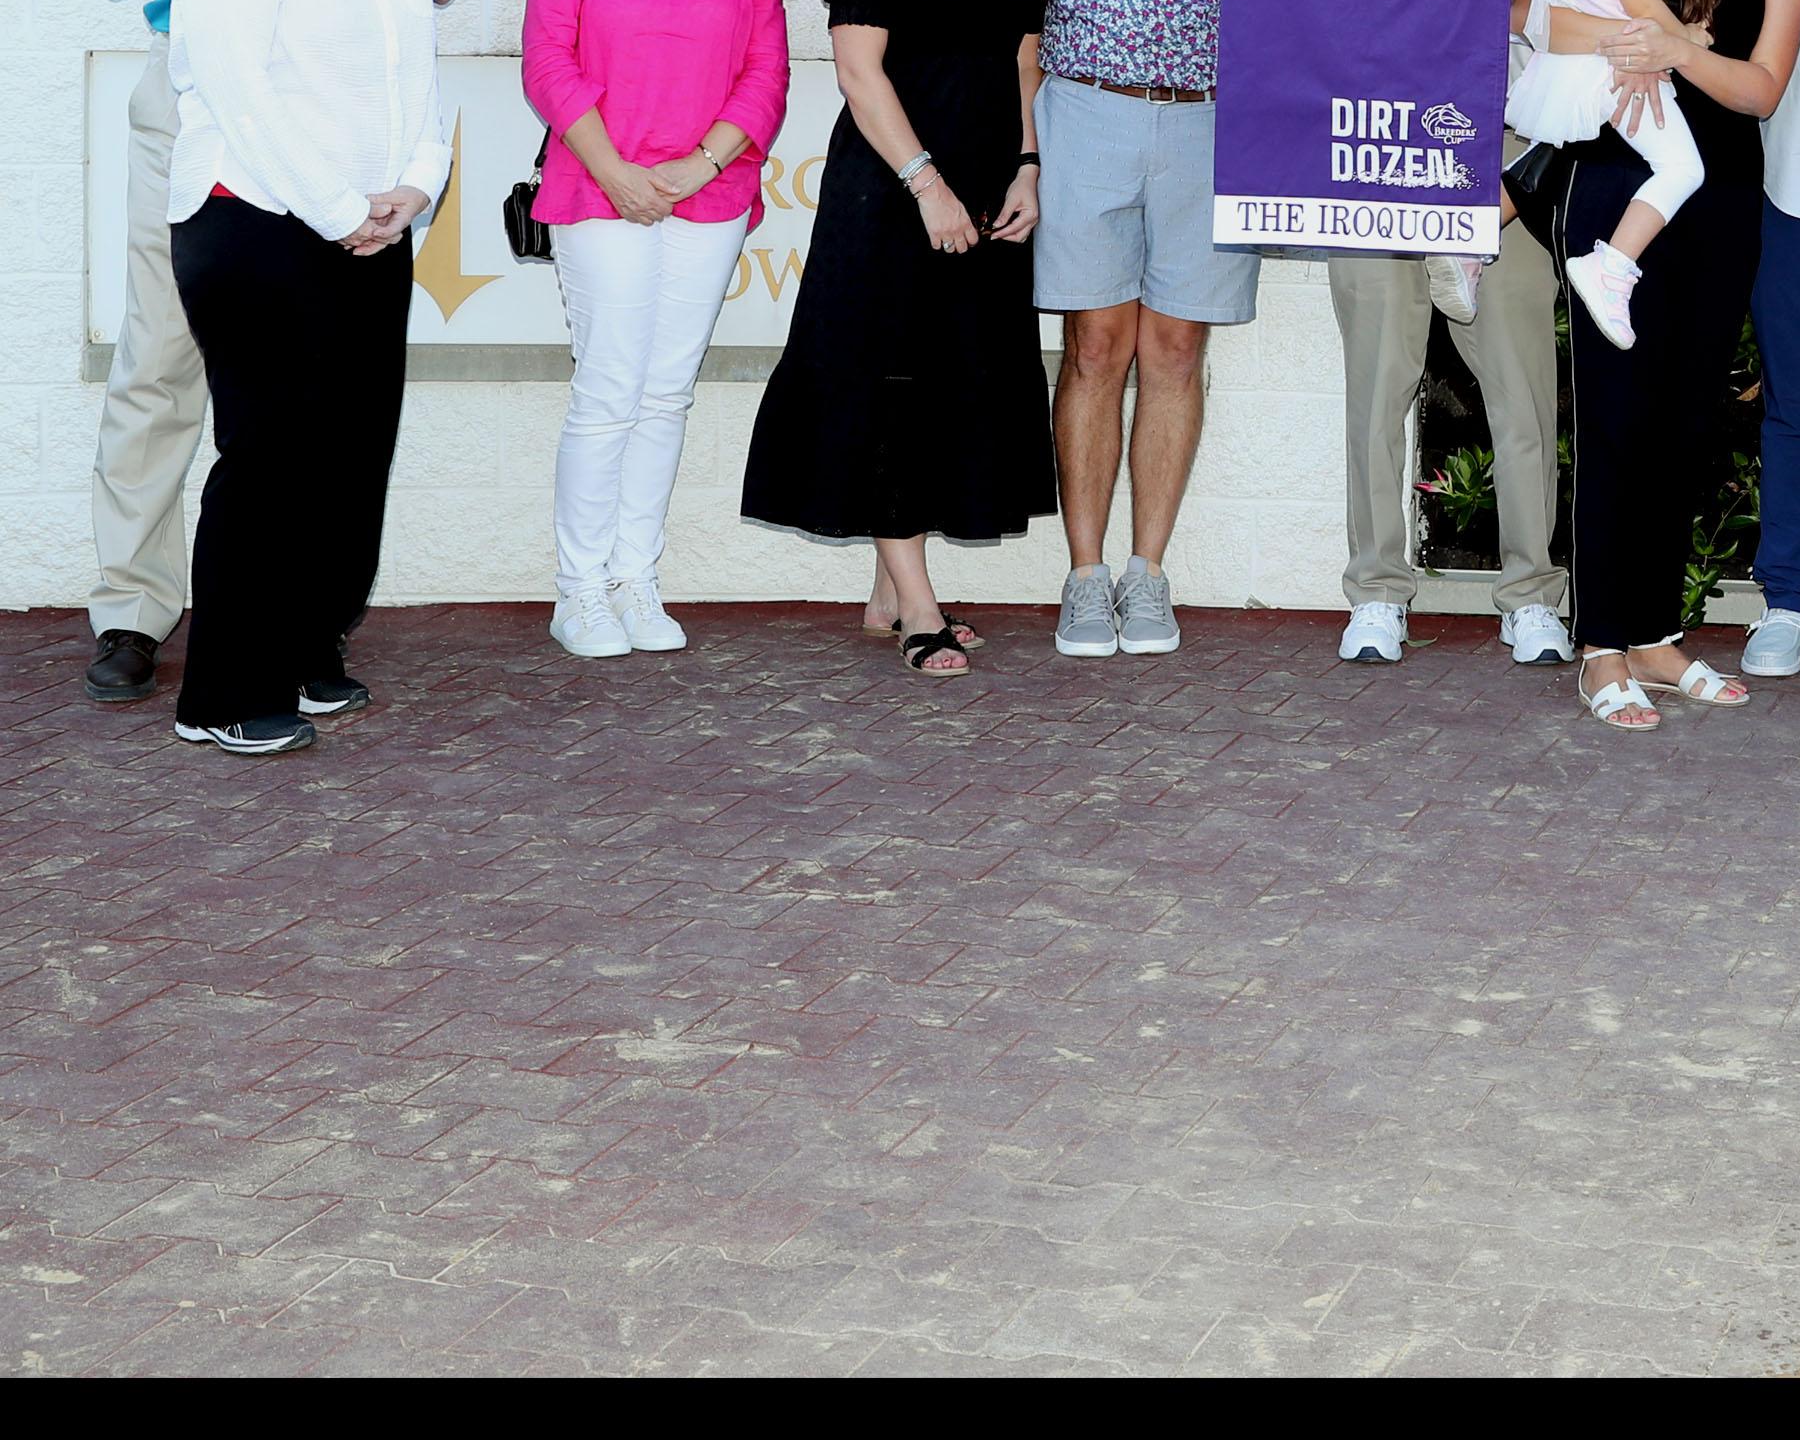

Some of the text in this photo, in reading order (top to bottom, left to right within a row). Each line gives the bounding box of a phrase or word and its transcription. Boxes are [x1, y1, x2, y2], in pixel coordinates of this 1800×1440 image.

[1331, 97, 1416, 141] DIRT
[1331, 142, 1457, 188] DOZEN
[1237, 201, 1475, 242] THE IROQUOIS
